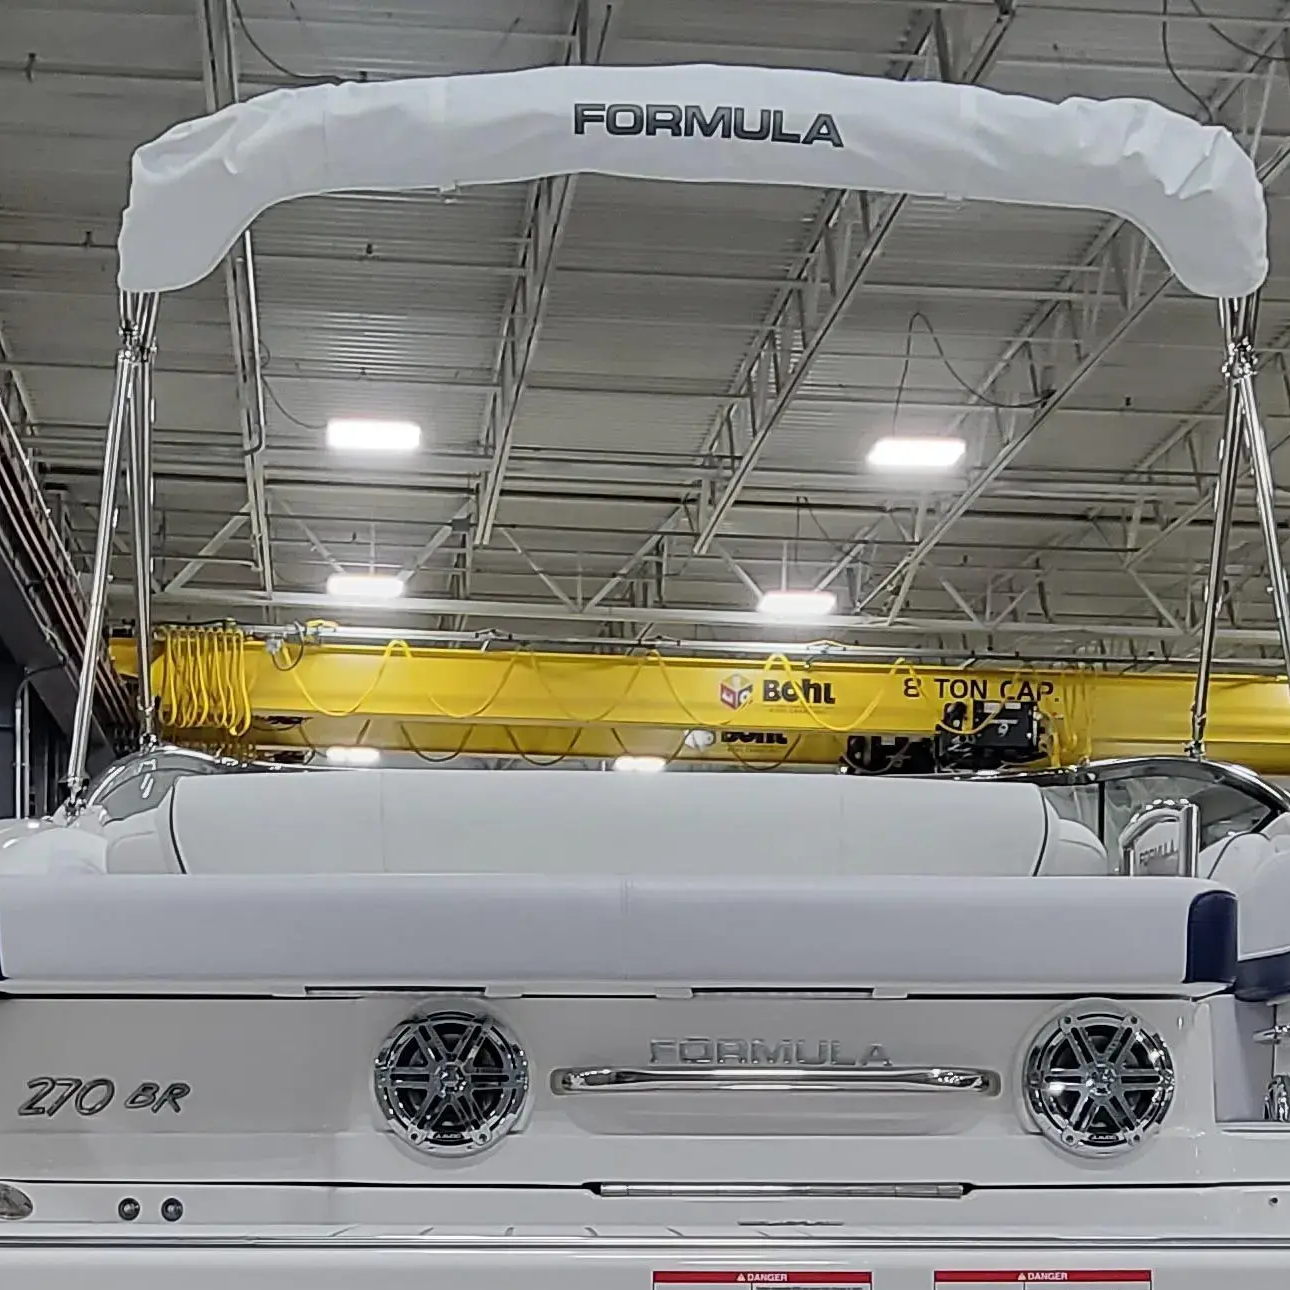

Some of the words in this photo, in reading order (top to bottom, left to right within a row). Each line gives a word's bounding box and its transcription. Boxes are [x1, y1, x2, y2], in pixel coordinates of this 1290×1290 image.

[573, 102, 845, 148] FORMULA
[903, 677, 922, 698] 8
[933, 678, 988, 699] TON
[999, 680, 1060, 702] CAP.
[649, 1036, 893, 1066] FORMULA
[17, 1076, 115, 1117] 270
[124, 1082, 192, 1114] BR
[747, 1273, 788, 1281] DANGER
[1027, 1272, 1068, 1281] DANGER
